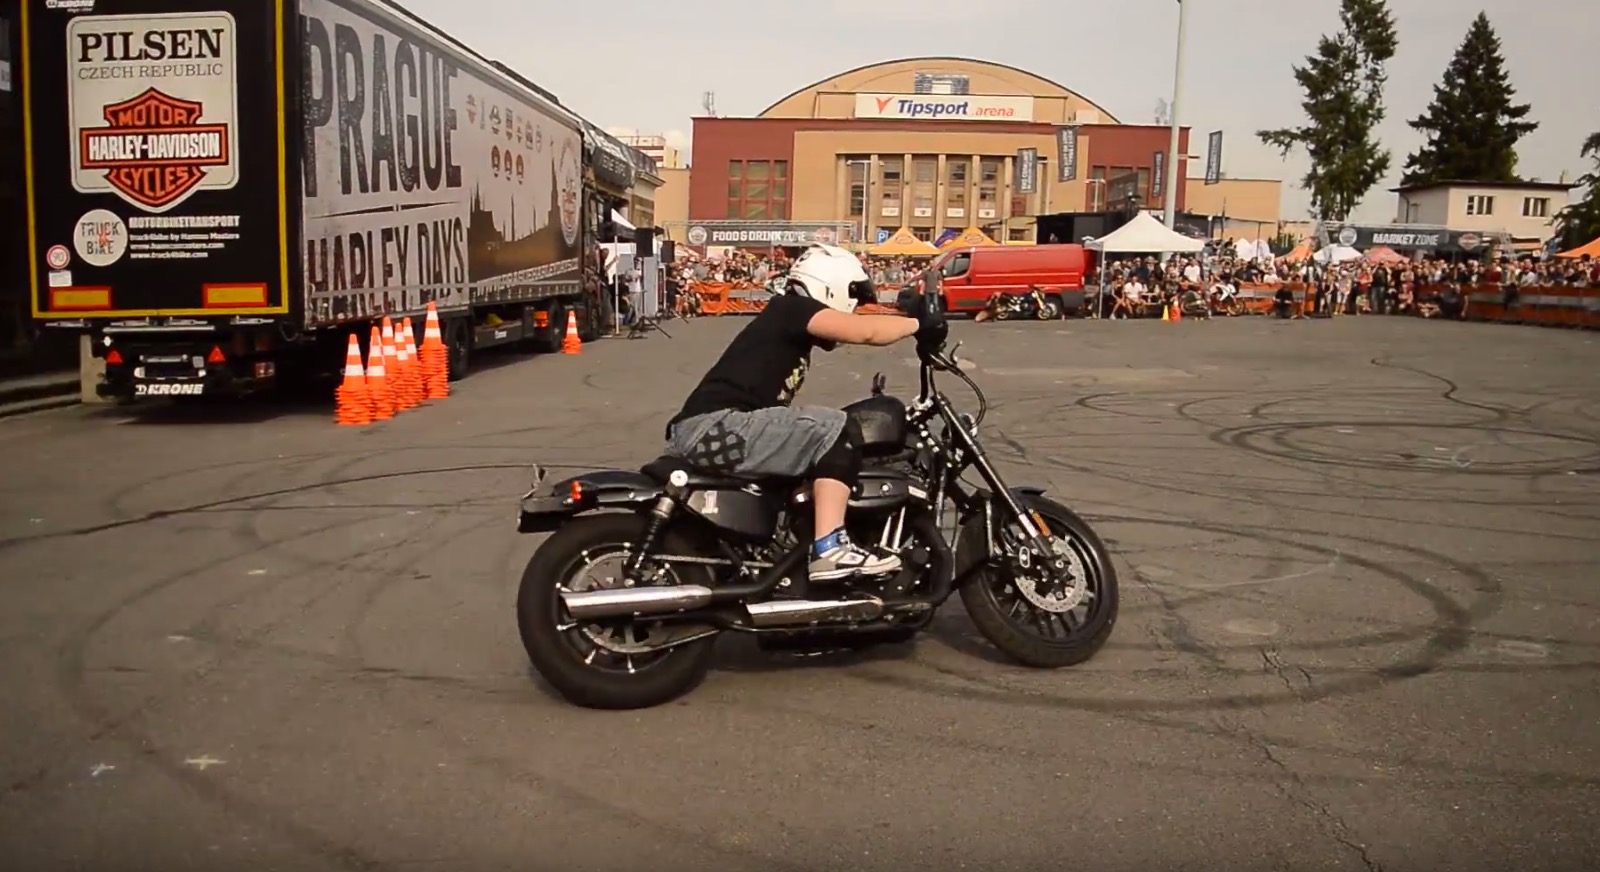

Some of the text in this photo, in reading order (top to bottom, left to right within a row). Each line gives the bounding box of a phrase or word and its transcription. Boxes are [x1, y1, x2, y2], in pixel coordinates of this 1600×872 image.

[77, 28, 225, 63] PILSEN
[78, 63, 224, 80] CZECH REPUBLIC
[117, 100, 189, 126] MOTOR
[300, 14, 462, 198] PRAGUE
[898, 99, 969, 117] Tipsport
[89, 132, 220, 160] HARLEY-DAVIDSON
[119, 167, 190, 198] CYCLES
[80, 221, 121, 237] TRUCK
[129, 215, 241, 229] MOTORBIKETRANSPORT
[783, 230, 806, 241] ZONE
[1372, 234, 1440, 246] MARKET ZONE
[87, 240, 114, 255] BIKE
[307, 216, 465, 318] HARLEY DAYS
[147, 383, 204, 395] KRONE
